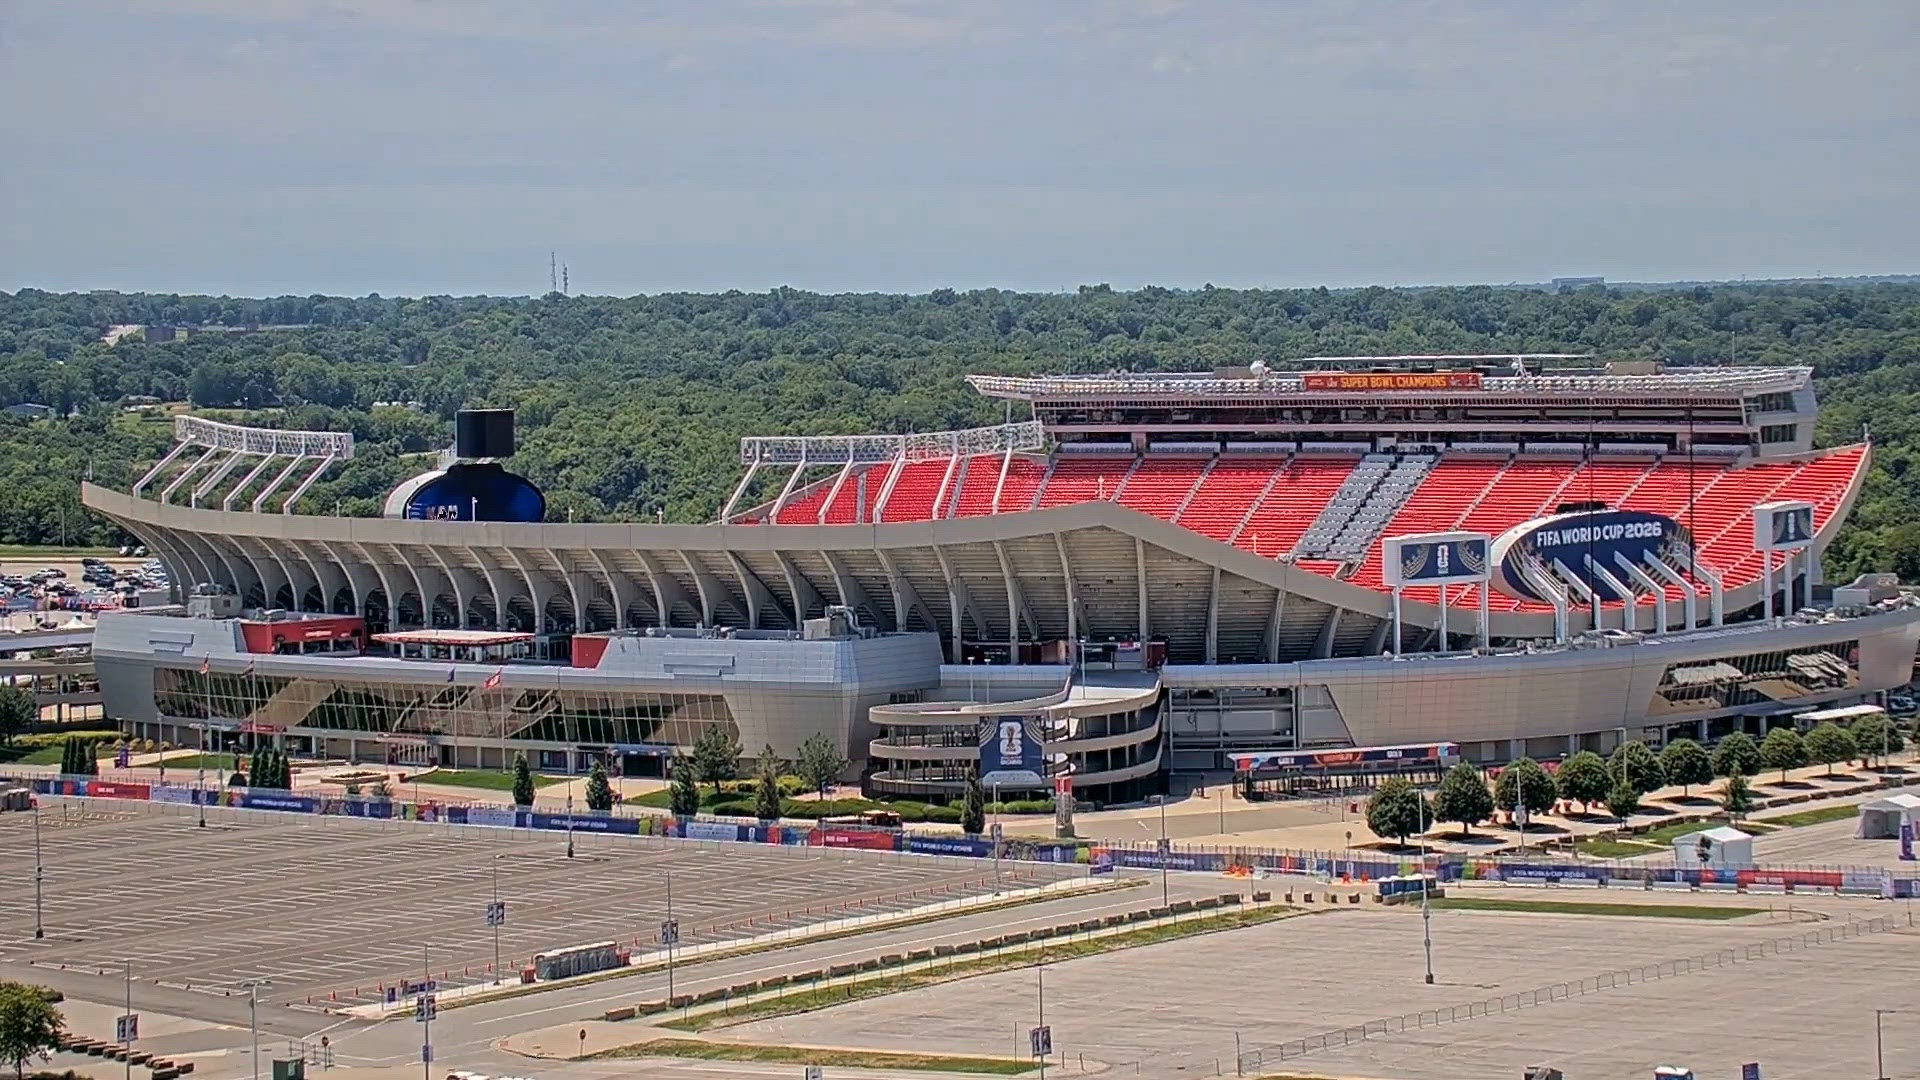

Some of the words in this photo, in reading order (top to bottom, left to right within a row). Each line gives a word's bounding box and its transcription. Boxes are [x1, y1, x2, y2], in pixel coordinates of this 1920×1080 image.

[1340, 376, 1368, 387] SUPER
[1370, 376, 1395, 387] BOWL
[1396, 376, 1447, 387] CHAMPIONS
[1537, 531, 1561, 548] FIFA
[1562, 528, 1602, 545] WORLD
[1602, 524, 1624, 541] CUP
[1625, 522, 1662, 538] 2026
